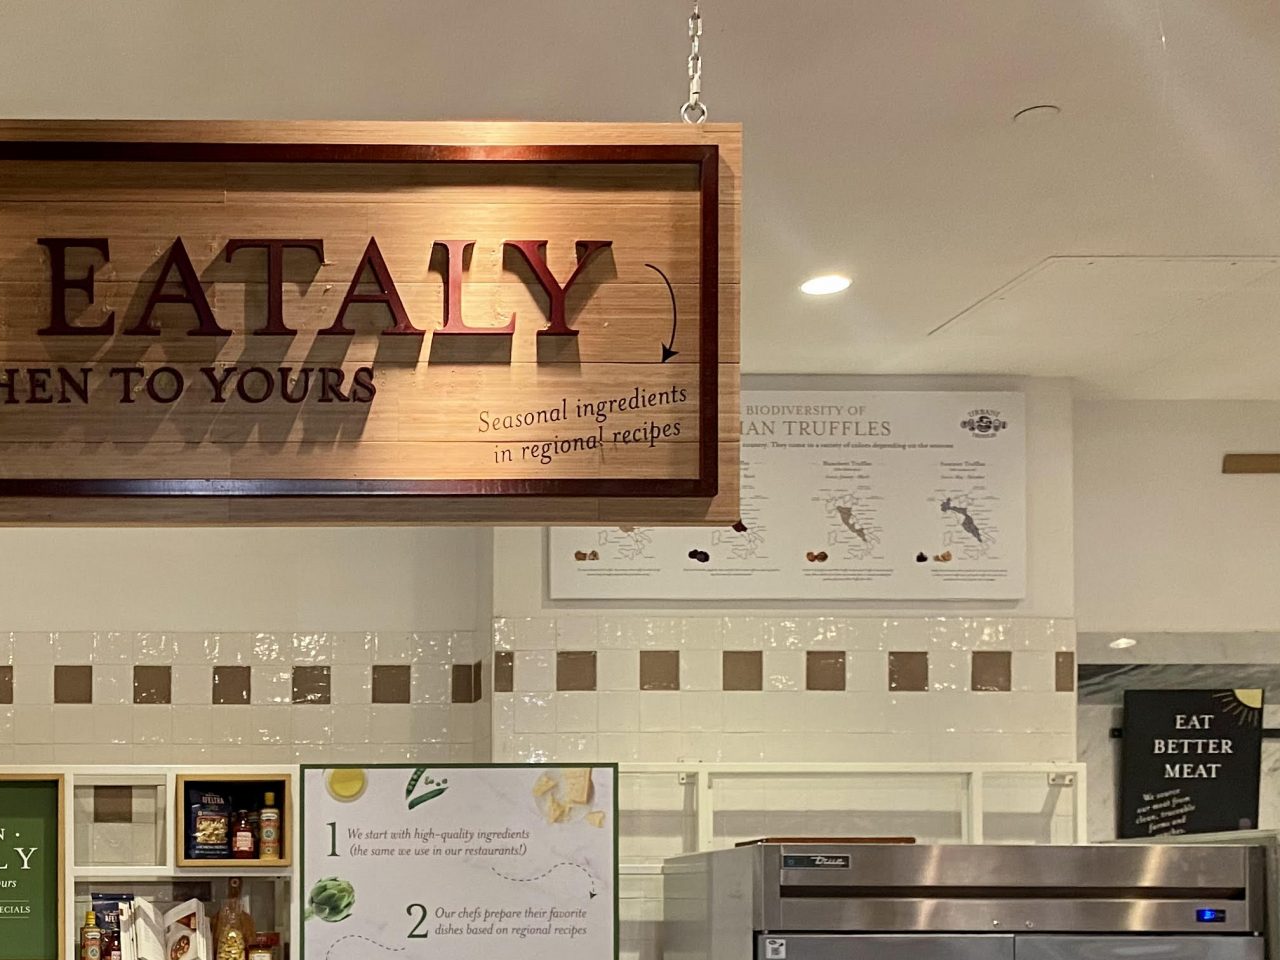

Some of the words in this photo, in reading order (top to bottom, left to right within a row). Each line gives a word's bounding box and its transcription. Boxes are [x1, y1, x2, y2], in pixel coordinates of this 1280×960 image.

[36, 235, 614, 338] EATALY
[109, 366, 185, 403] TO
[199, 366, 377, 404] YOURS
[478, 398, 568, 433] Seasonal
[576, 385, 688, 423] ingredients
[746, 405, 843, 416] BIODIVERSITY
[847, 406, 867, 415] OF
[783, 420, 892, 436] TRUFFLES
[493, 445, 513, 464] in
[521, 426, 604, 465] regional
[612, 421, 681, 448] recipes
[1175, 715, 1215, 729] EAT
[1153, 739, 1234, 754] BETTER
[1164, 764, 1222, 778] MEAT
[326, 821, 340, 857] 1
[348, 828, 363, 839] We
[364, 828, 388, 839] start
[391, 828, 411, 840] with
[413, 828, 474, 843] high-quality
[477, 828, 530, 843] ingredients
[350, 844, 368, 857] (the
[370, 847, 395, 856] same
[398, 847, 411, 856] we
[414, 848, 430, 856] use
[432, 845, 442, 856] in
[444, 848, 462, 856] our
[464, 843, 527, 857] restaurants!)
[406, 903, 429, 939] 2
[435, 907, 456, 919] Our
[458, 906, 482, 922] chefs
[483, 909, 522, 922] prepare
[524, 907, 547, 919] their
[547, 906, 587, 922] favorite
[434, 923, 464, 935] dishes
[466, 923, 494, 935] based
[495, 927, 509, 935] on
[511, 923, 551, 939] regional
[553, 924, 587, 938] recipes
